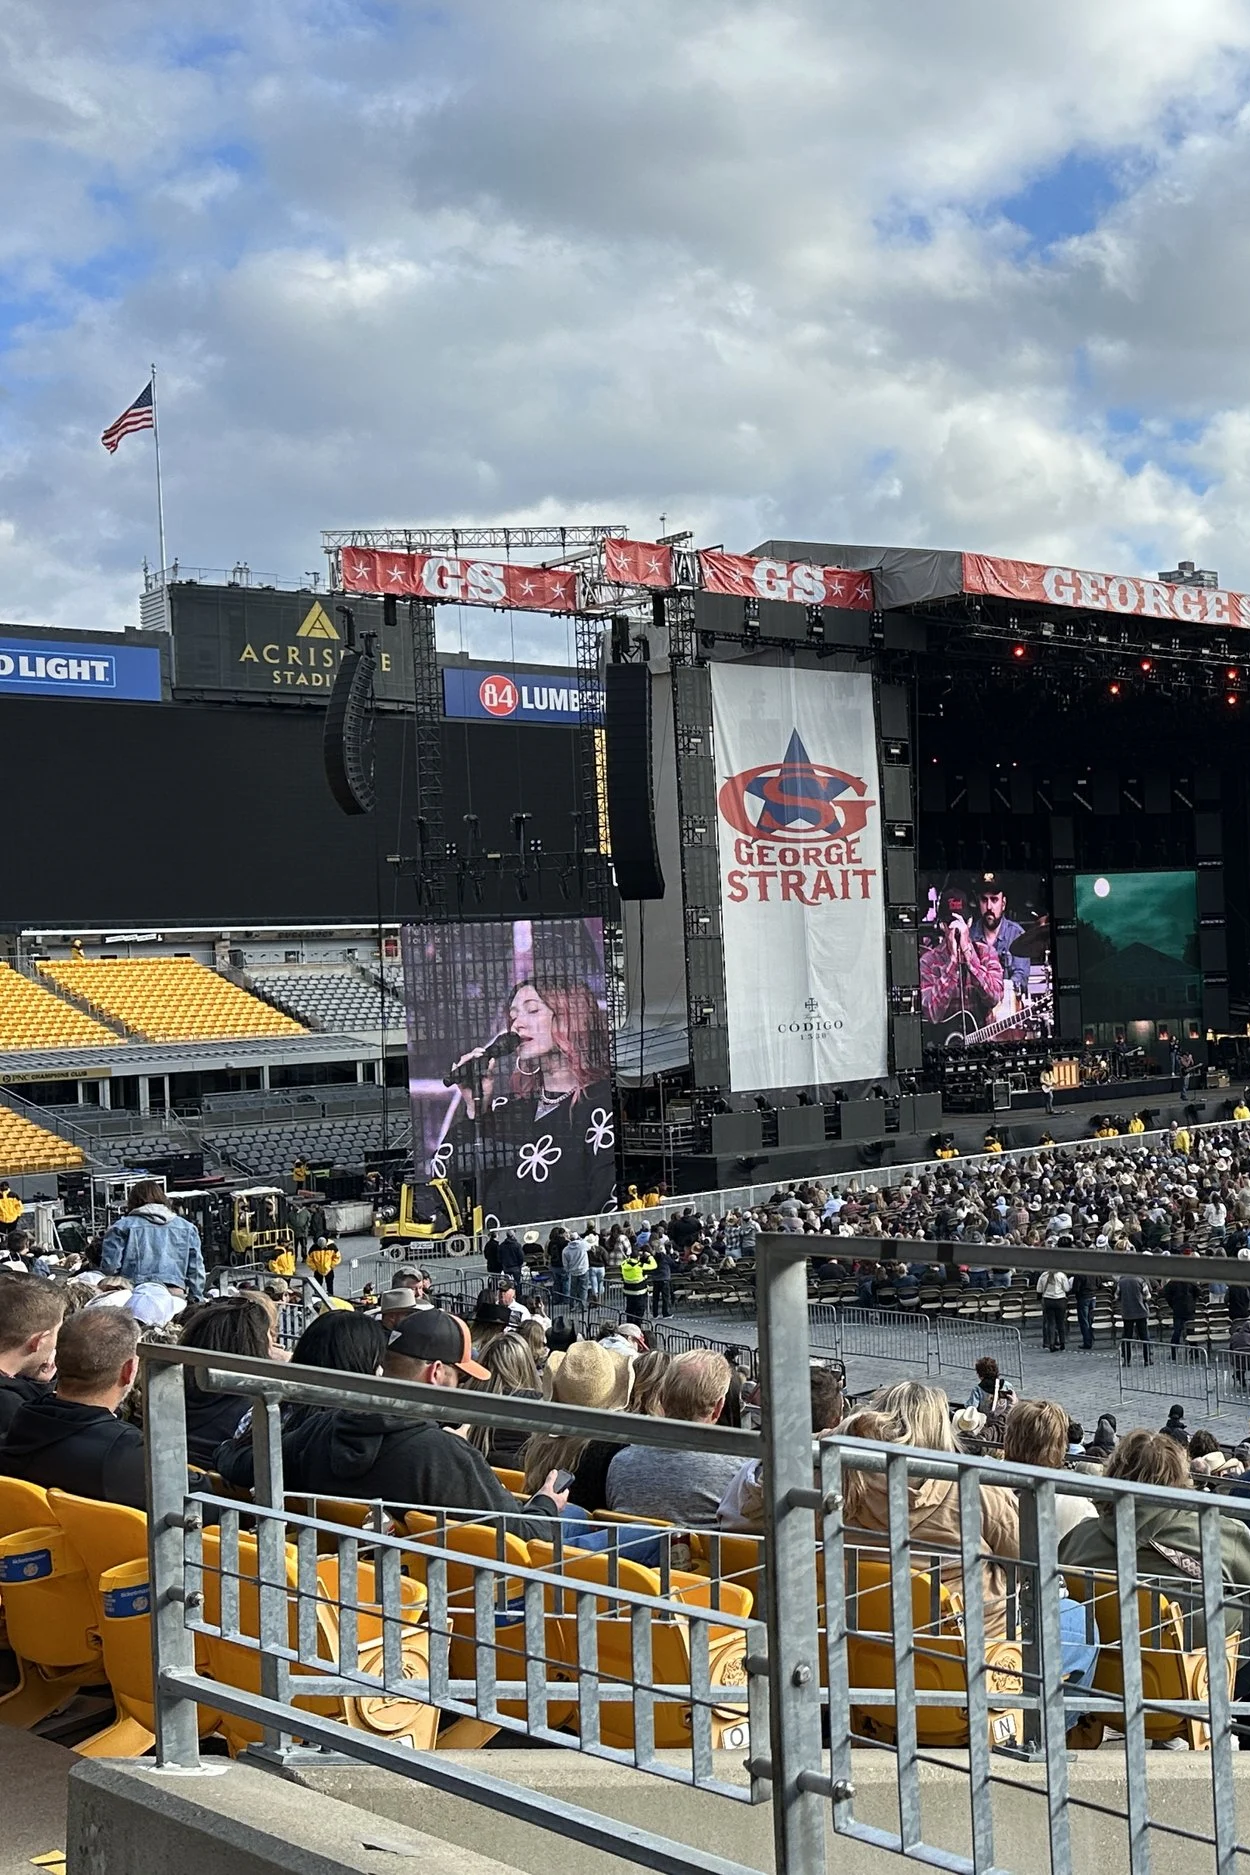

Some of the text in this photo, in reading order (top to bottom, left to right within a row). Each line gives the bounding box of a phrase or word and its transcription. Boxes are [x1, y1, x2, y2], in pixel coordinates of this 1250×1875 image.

[420, 557, 507, 602] GS
[751, 560, 827, 603] GS
[1042, 567, 1230, 624] GEORGE
[18, 655, 109, 682] LIGHT
[239, 643, 392, 672] ACRISE
[484, 683, 514, 708] 84
[734, 835, 863, 868] GEORGE
[726, 868, 877, 907] STRAIT
[999, 1716, 1011, 1738] N
